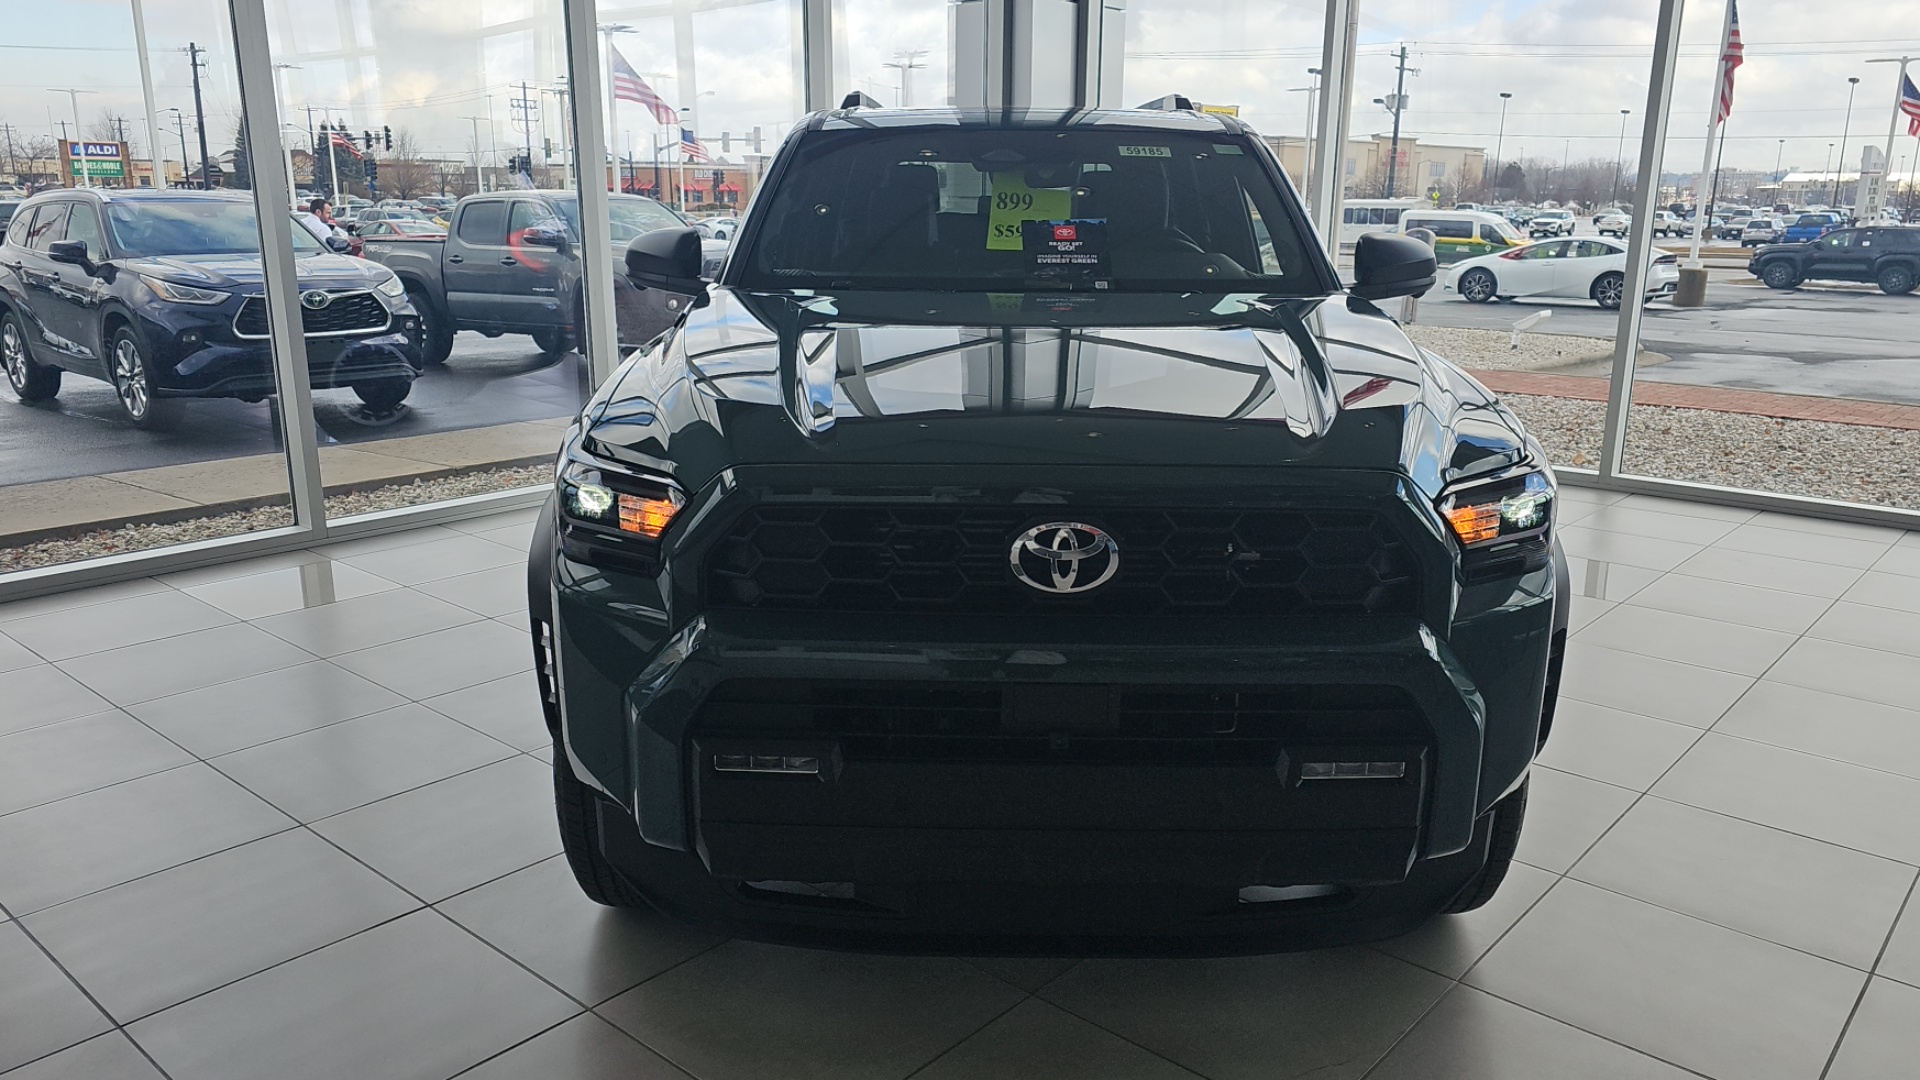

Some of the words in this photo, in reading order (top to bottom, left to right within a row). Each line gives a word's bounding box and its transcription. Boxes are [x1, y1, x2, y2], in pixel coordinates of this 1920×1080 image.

[88, 145, 116, 154] ALDI
[1126, 147, 1164, 155] 59185
[996, 191, 1034, 211] 899
